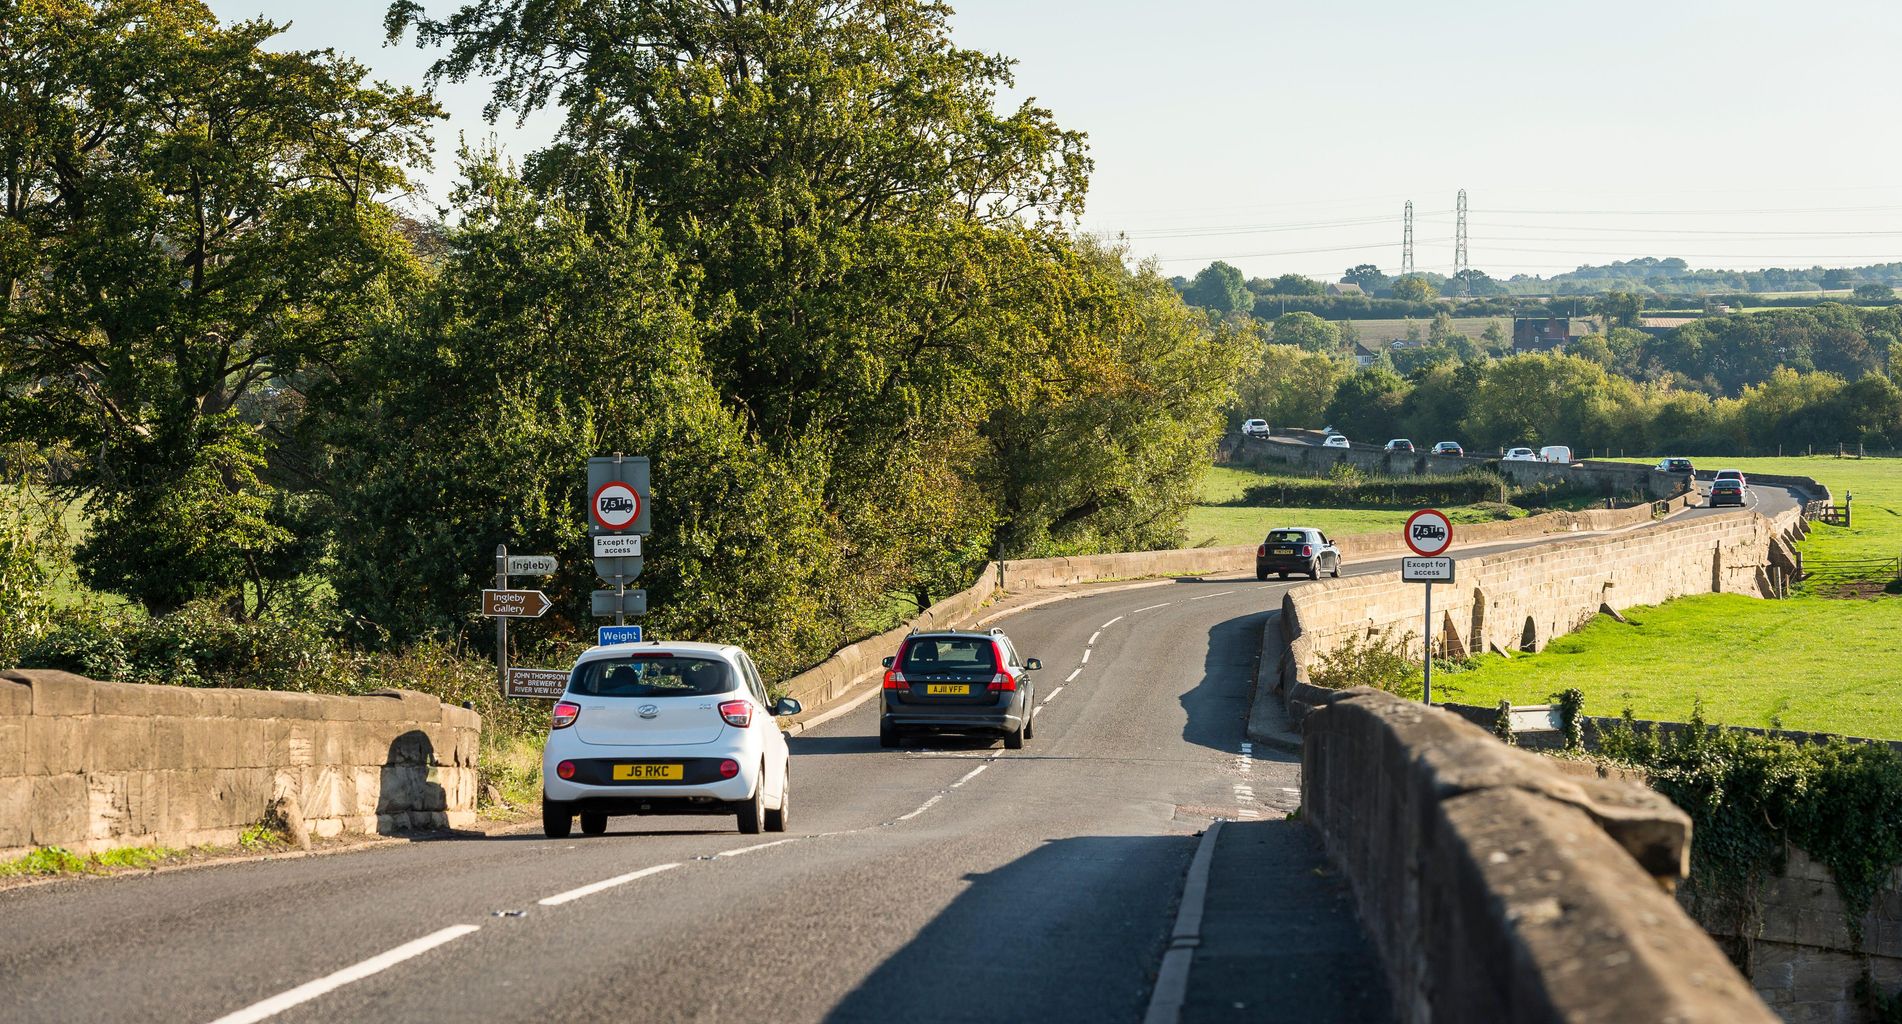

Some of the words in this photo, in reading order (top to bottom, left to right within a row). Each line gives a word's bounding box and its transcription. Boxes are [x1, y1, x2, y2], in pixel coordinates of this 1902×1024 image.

[602, 498, 622, 508] 7.5T
[1415, 526, 1435, 536] 7.5T
[513, 561, 550, 571] Ingleby
[493, 593, 525, 604] Ingleby
[493, 604, 525, 614] Gallery
[603, 631, 637, 642] Weight
[626, 766, 642, 776] J6
[645, 766, 669, 776] RKC
